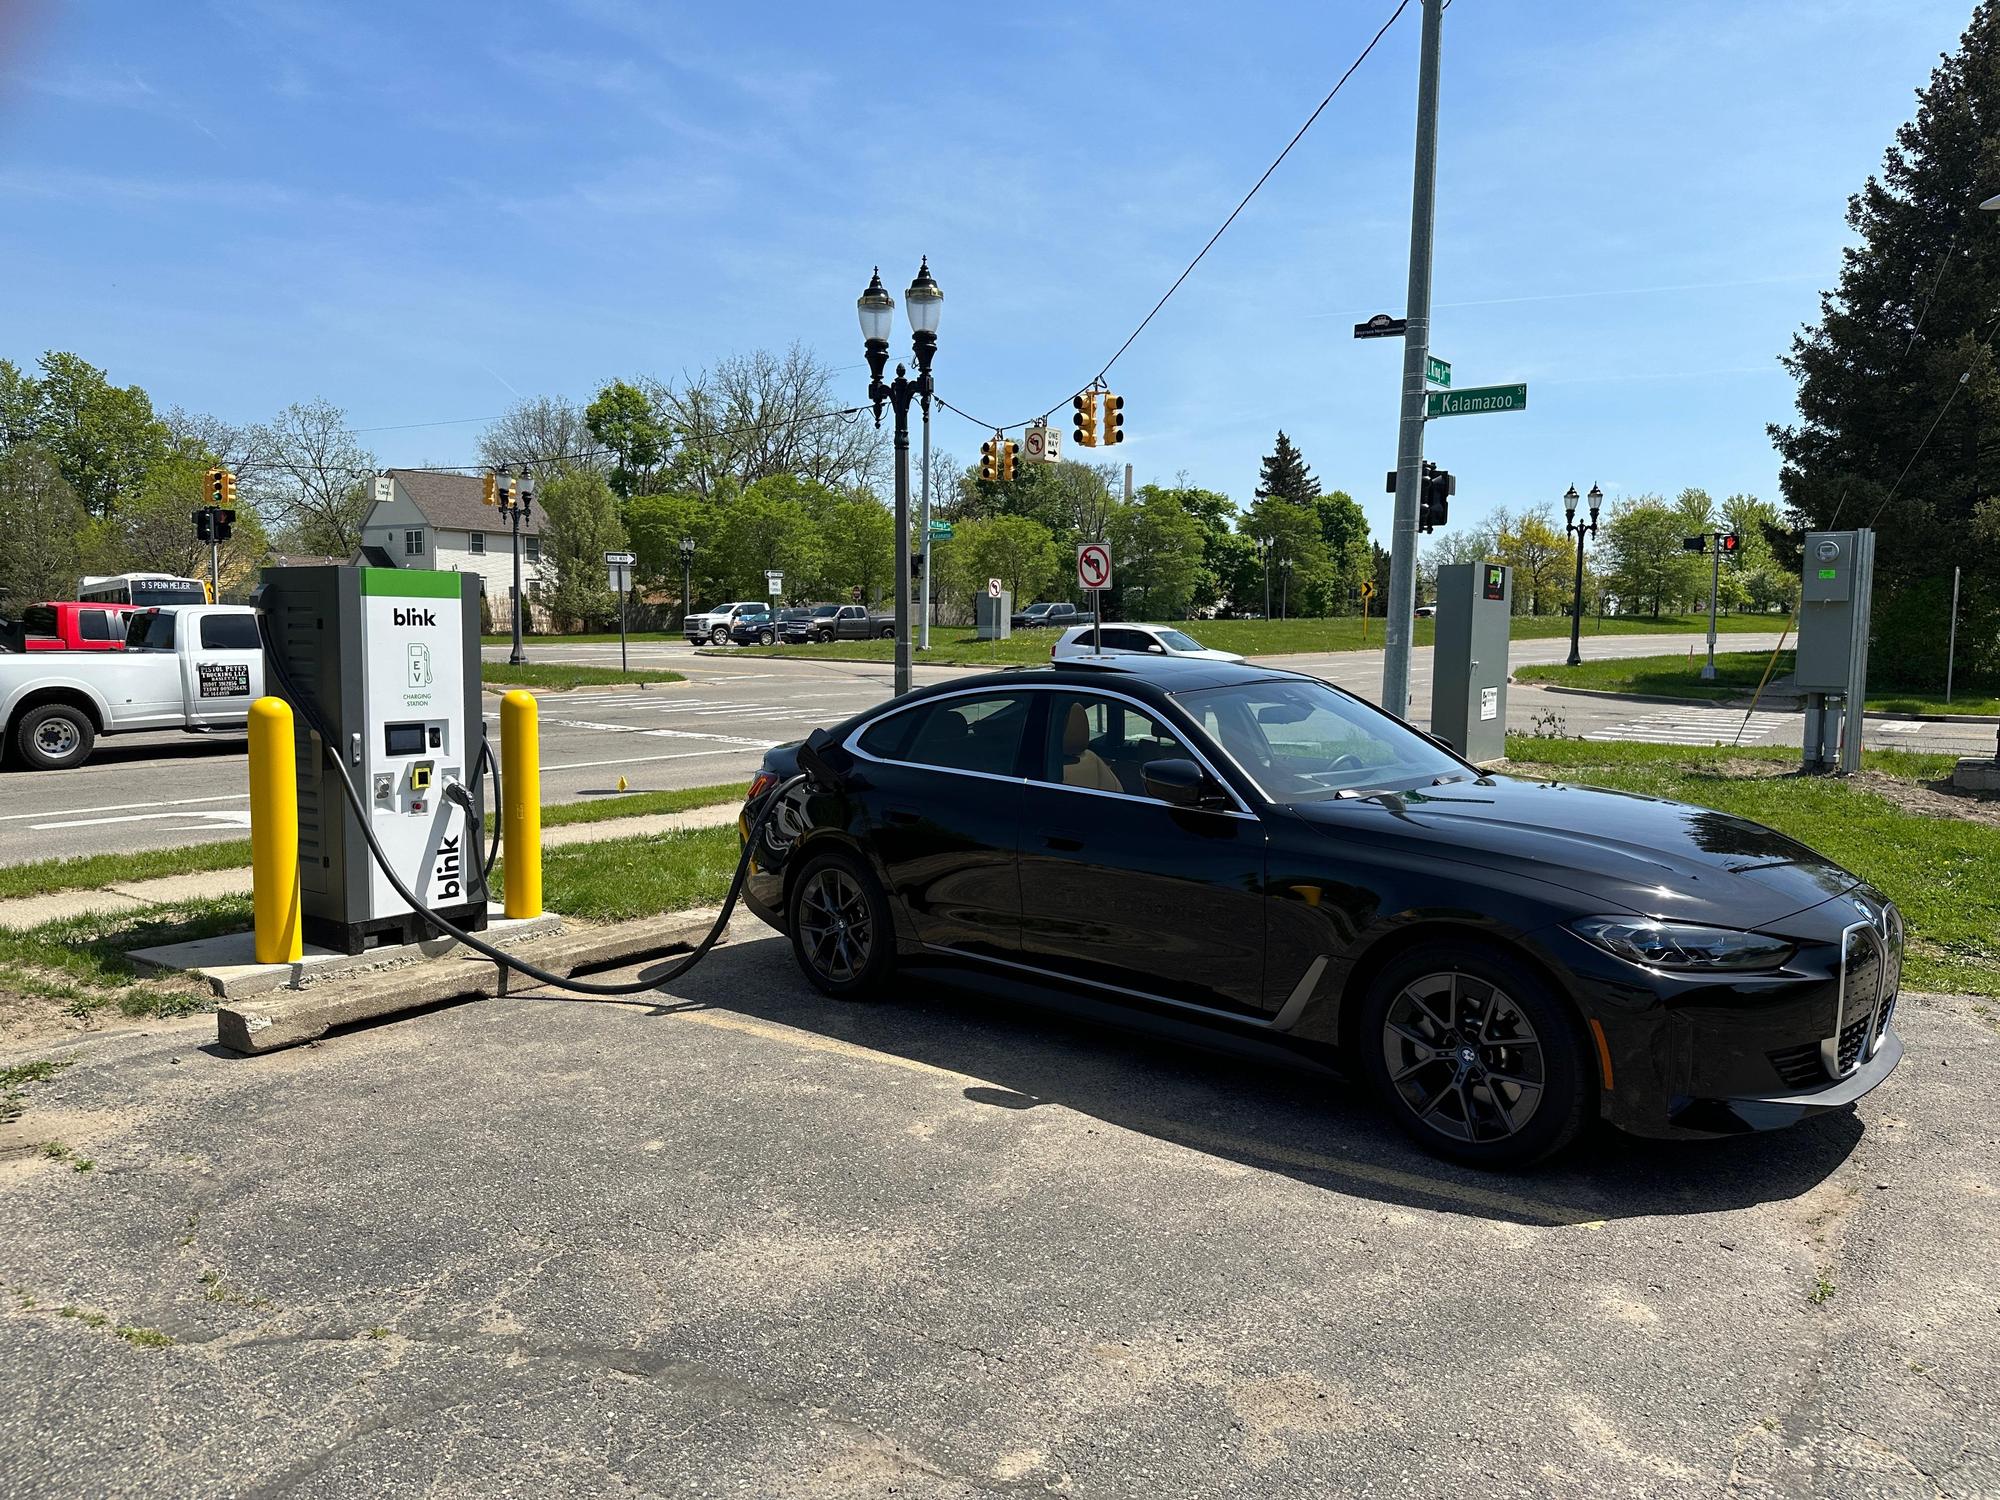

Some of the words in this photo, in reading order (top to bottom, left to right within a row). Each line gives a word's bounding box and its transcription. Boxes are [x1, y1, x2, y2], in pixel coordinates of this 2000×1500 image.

[1430, 394, 1436, 402] W
[1442, 394, 1513, 413] Kalamazoo
[1517, 386, 1525, 395] St
[1048, 432, 1058, 440] ONE
[153, 582, 169, 590] PENN
[169, 582, 191, 590] MEIJER
[393, 608, 437, 626] blink
[436, 835, 460, 900] blink
